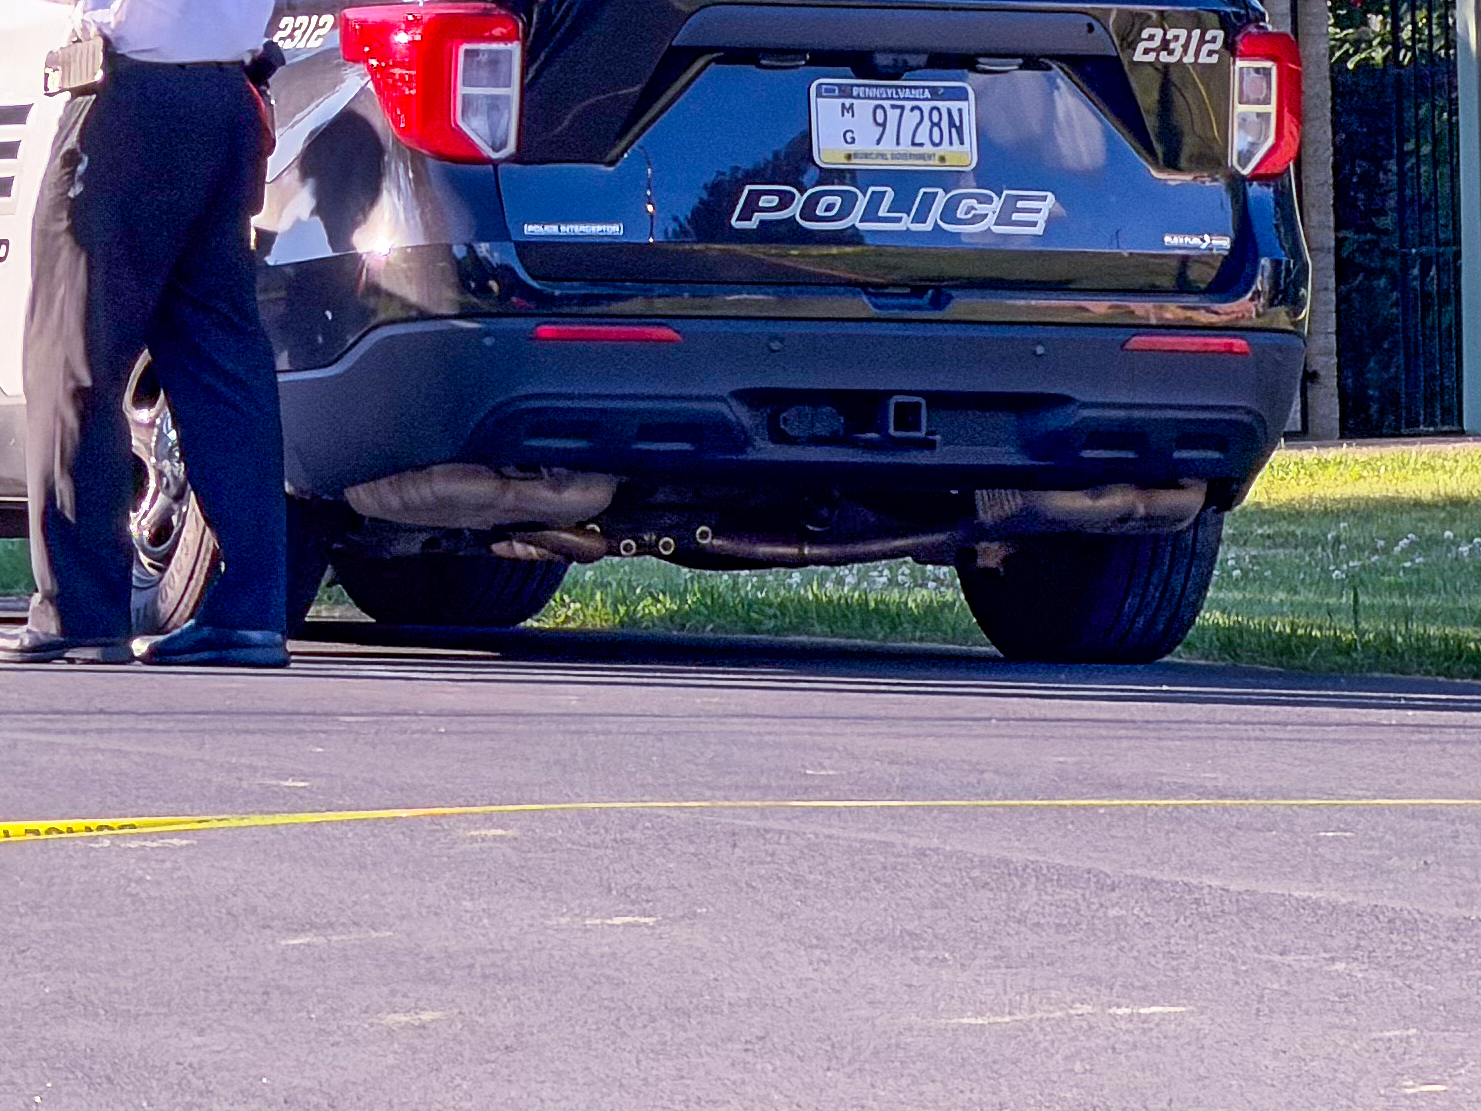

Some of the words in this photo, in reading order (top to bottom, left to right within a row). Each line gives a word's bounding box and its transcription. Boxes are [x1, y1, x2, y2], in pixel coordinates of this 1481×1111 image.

[273, 14, 335, 49] 2312
[1133, 27, 1226, 64] 2312
[840, 102, 855, 118] M
[852, 86, 931, 99] PENNSYLVANIA
[842, 129, 856, 145] G
[872, 103, 965, 148] 9728N
[730, 184, 1056, 236] POLICE
